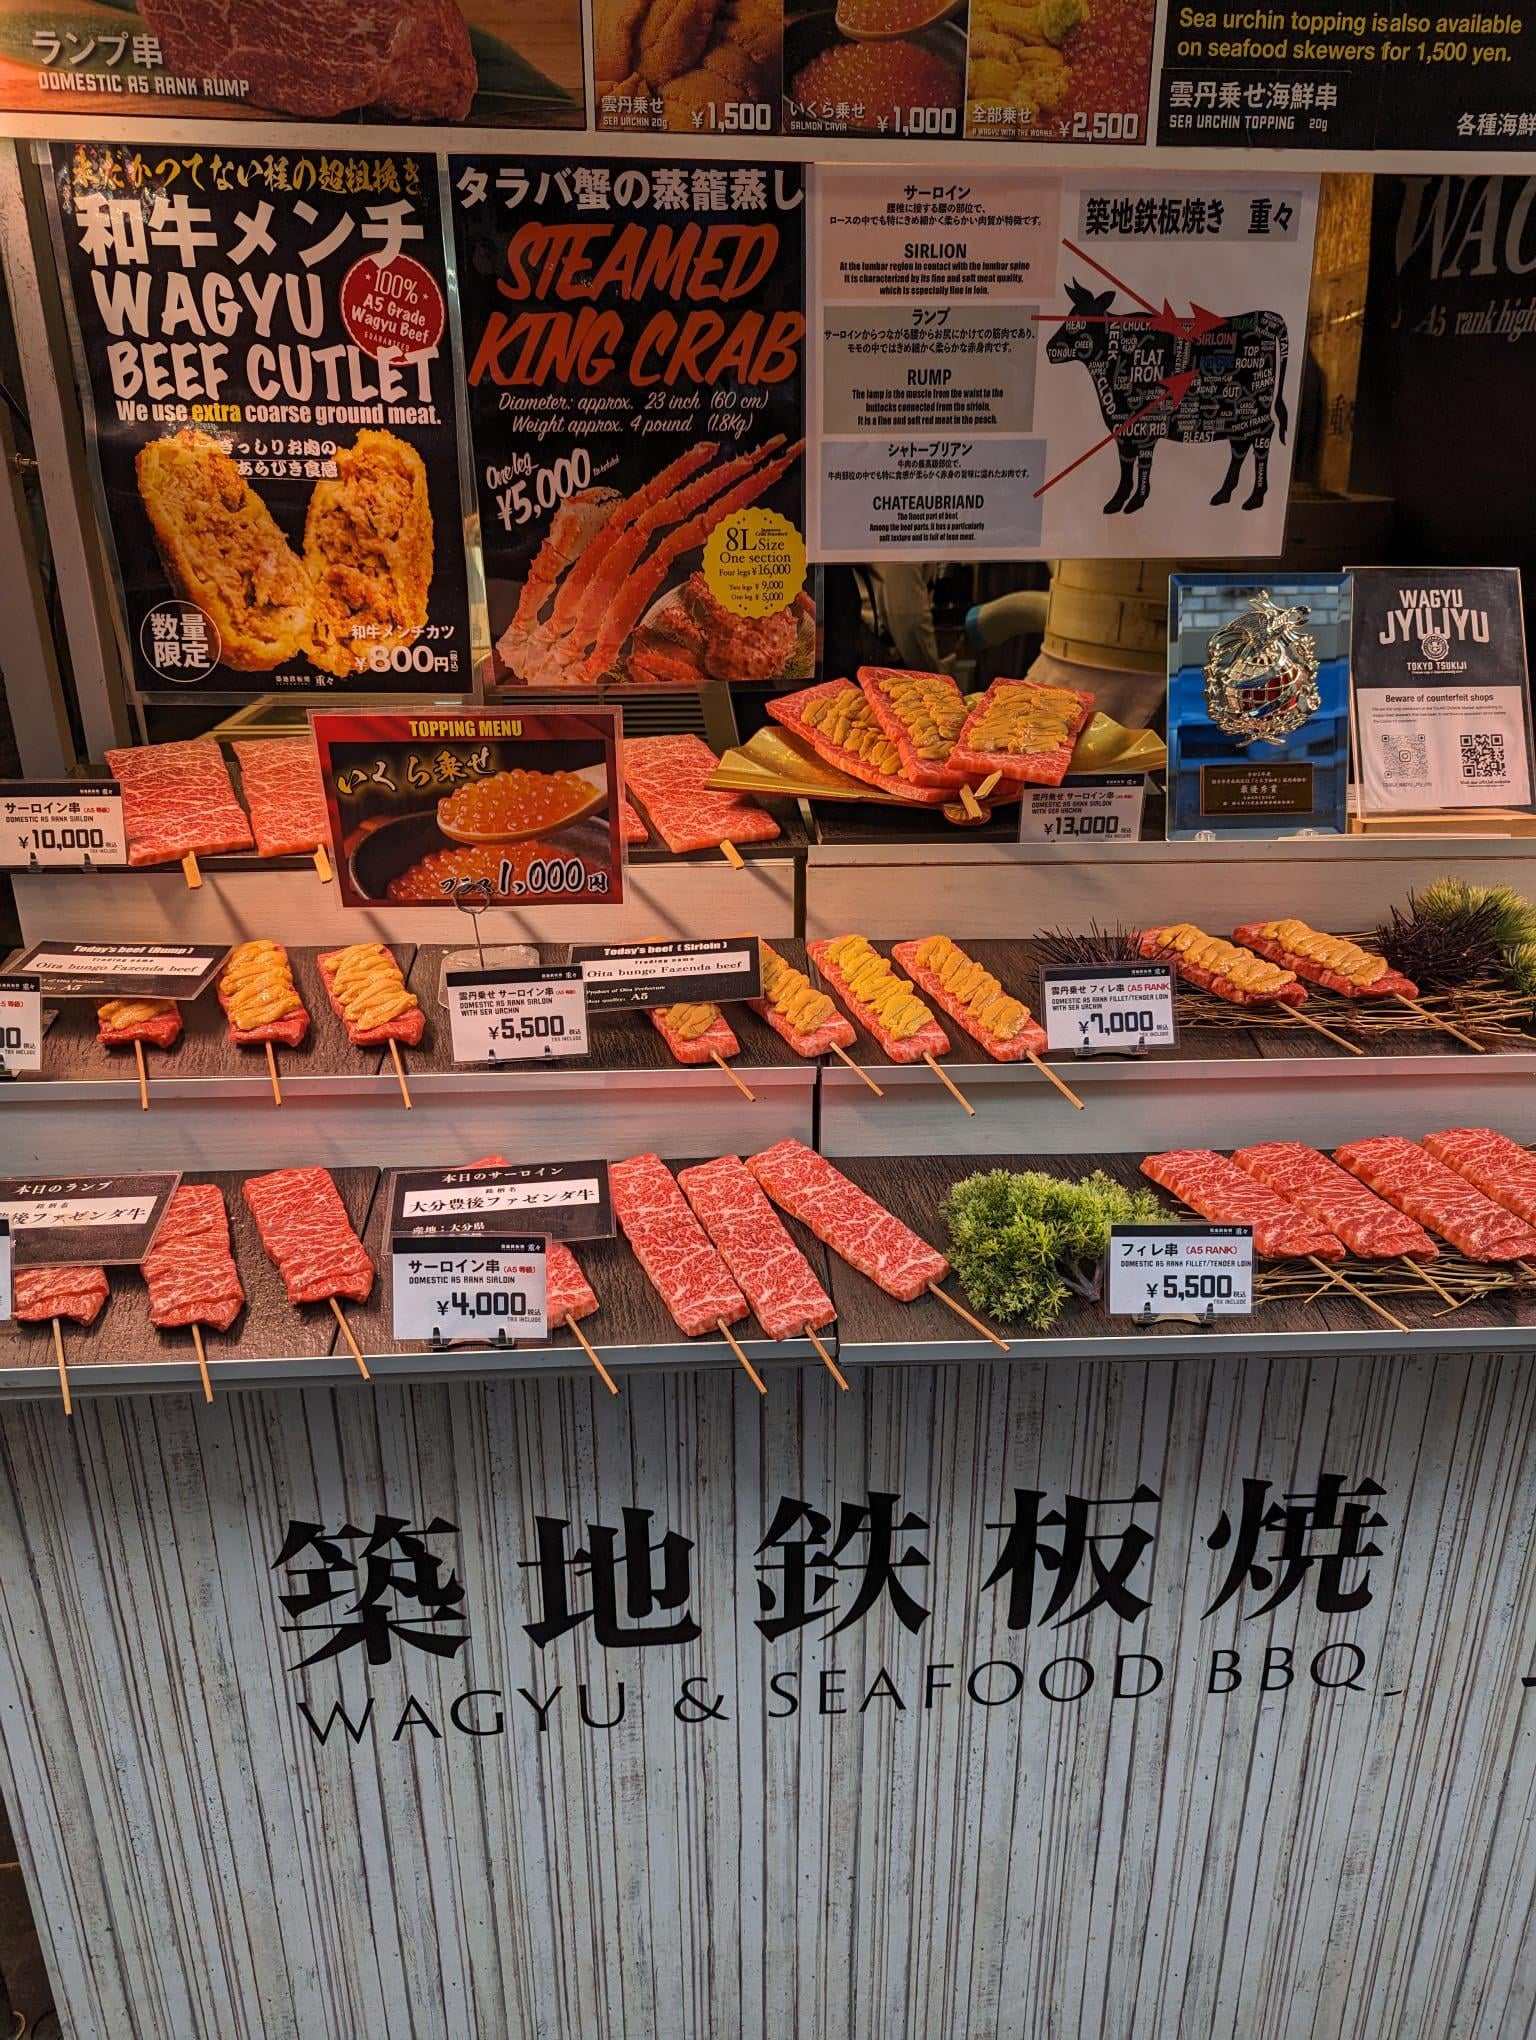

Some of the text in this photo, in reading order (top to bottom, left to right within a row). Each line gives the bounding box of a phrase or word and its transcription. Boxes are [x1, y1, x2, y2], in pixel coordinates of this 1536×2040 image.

[1180, 8, 1523, 36] Sea urchin topping available
[32, 31, 164, 69] ランプ串
[1177, 40, 1512, 67] on seafood skewers for 1,500 yen.
[38, 72, 250, 98] DOMESTIC A5 RANK RUMP
[601, 95, 663, 114] 雲丹乗せ
[1169, 81, 1338, 110] 雲丹乗せ海鮮串
[691, 102, 772, 134] ¥1,500
[789, 102, 866, 119] いくら乗せ
[972, 103, 1032, 124] 全部乗せ
[603, 117, 667, 130] SEA URCHIN 20g
[790, 119, 823, 131] SALMON
[877, 106, 957, 136] ¥1,000
[1058, 111, 1139, 142] ¥2,500
[1169, 115, 1328, 132] SEA URCHIN TOPPING 20g
[456, 166, 805, 212] タラバ蟹の蒸籠蒸し
[904, 185, 971, 200] サーロイン
[1085, 198, 1294, 235] 築地鉄板焼き 重々
[75, 193, 424, 269] 和牛メンチ
[904, 243, 967, 259] SIRLION
[497, 221, 780, 302] STEAMED
[374, 269, 418, 304] 100%
[91, 270, 325, 338] WAGYU
[363, 293, 426, 327] A5 Grade
[351, 304, 430, 344] Wagyu Beef
[912, 308, 951, 326] ランプ
[1454, 300, 1496, 335] rank
[468, 306, 807, 388] KING CRAB
[1244, 346, 1260, 356] TOP
[1133, 348, 1165, 366] FLAT
[1235, 359, 1265, 369] ROUND
[106, 342, 440, 404] BEEF CUTLET
[907, 369, 952, 386] RUMP
[1130, 366, 1165, 383] IRON
[1097, 376, 1116, 415] CLOD
[1222, 387, 1240, 398] GUT
[116, 400, 443, 426] We use extra coarse ground meat.
[498, 390, 769, 417] Diameter: approx. 23 inch (60 cm)
[512, 414, 692, 440] Weight approx. 4 pound
[1149, 423, 1168, 436] RIB
[1183, 431, 1216, 443] BLEAST
[1255, 438, 1270, 449] LEG
[888, 442, 973, 458] シャトーブリアン
[237, 460, 339, 478] あらびき食感
[486, 452, 540, 489] One leg
[495, 447, 591, 531] ¥5,000
[872, 495, 985, 511] CHATEAUBRIAND
[726, 527, 757, 552] 8L
[758, 538, 785, 551] Size
[719, 551, 791, 563] One section
[719, 568, 735, 577] Four
[1398, 589, 1463, 609] WAGYU
[151, 613, 207, 642] 数量
[351, 624, 455, 640] 和牛メンチカツ
[1379, 607, 1490, 645] JYUJYU
[152, 641, 212, 669] 限定
[1406, 661, 1468, 671] TOKYO TSUKIJI
[1385, 694, 1494, 704] Beware of counterfeit shops
[409, 720, 522, 737] TOPPING MENU
[336, 744, 498, 796] いくら乗せ
[4, 802, 81, 814] サーロイン串
[1043, 816, 1119, 837] ¥13,000
[18, 829, 104, 852] ¥10,000
[497, 857, 609, 896] 1,000円
[73, 945, 147, 954] Today's beef
[604, 944, 674, 957] Today's beef
[36, 962, 199, 974] Oita bungo Fazenda beef
[587, 969, 614, 979] Oita
[618, 967, 656, 978] bungo
[661, 964, 712, 974] Fazenda
[716, 960, 743, 970] beef
[498, 987, 554, 999] サーロイン串
[630, 993, 649, 1001] A5
[1089, 983, 1170, 993] フィレ串 RANK
[459, 997, 553, 1010] DOMESTIC RANK SIRLOIN
[1051, 997, 1081, 1005] DOMESTIC
[460, 1007, 520, 1017] WITH URCHIN
[487, 1015, 565, 1042] ¥5,500
[1078, 1010, 1154, 1036] ¥7,000
[441, 1167, 565, 1184] 本日のサーロイン
[12, 1181, 114, 1195] 本日のランプ
[408, 1188, 596, 1213] 大分豊後ファゼンダ牛
[1121, 1243, 1178, 1256] フィレ串
[408, 1259, 500, 1274] サーロイン串
[409, 1276, 516, 1284] DOMESTIC A5 RANK SIRLOIN
[1146, 1274, 1233, 1301] ¥5,500
[436, 1292, 542, 1319] ¥4,000 税込
[272, 1474, 1391, 1671] 築地鉄板焼
[297, 1641, 1404, 1747] WAGYU & SEAFOOD BBQ
